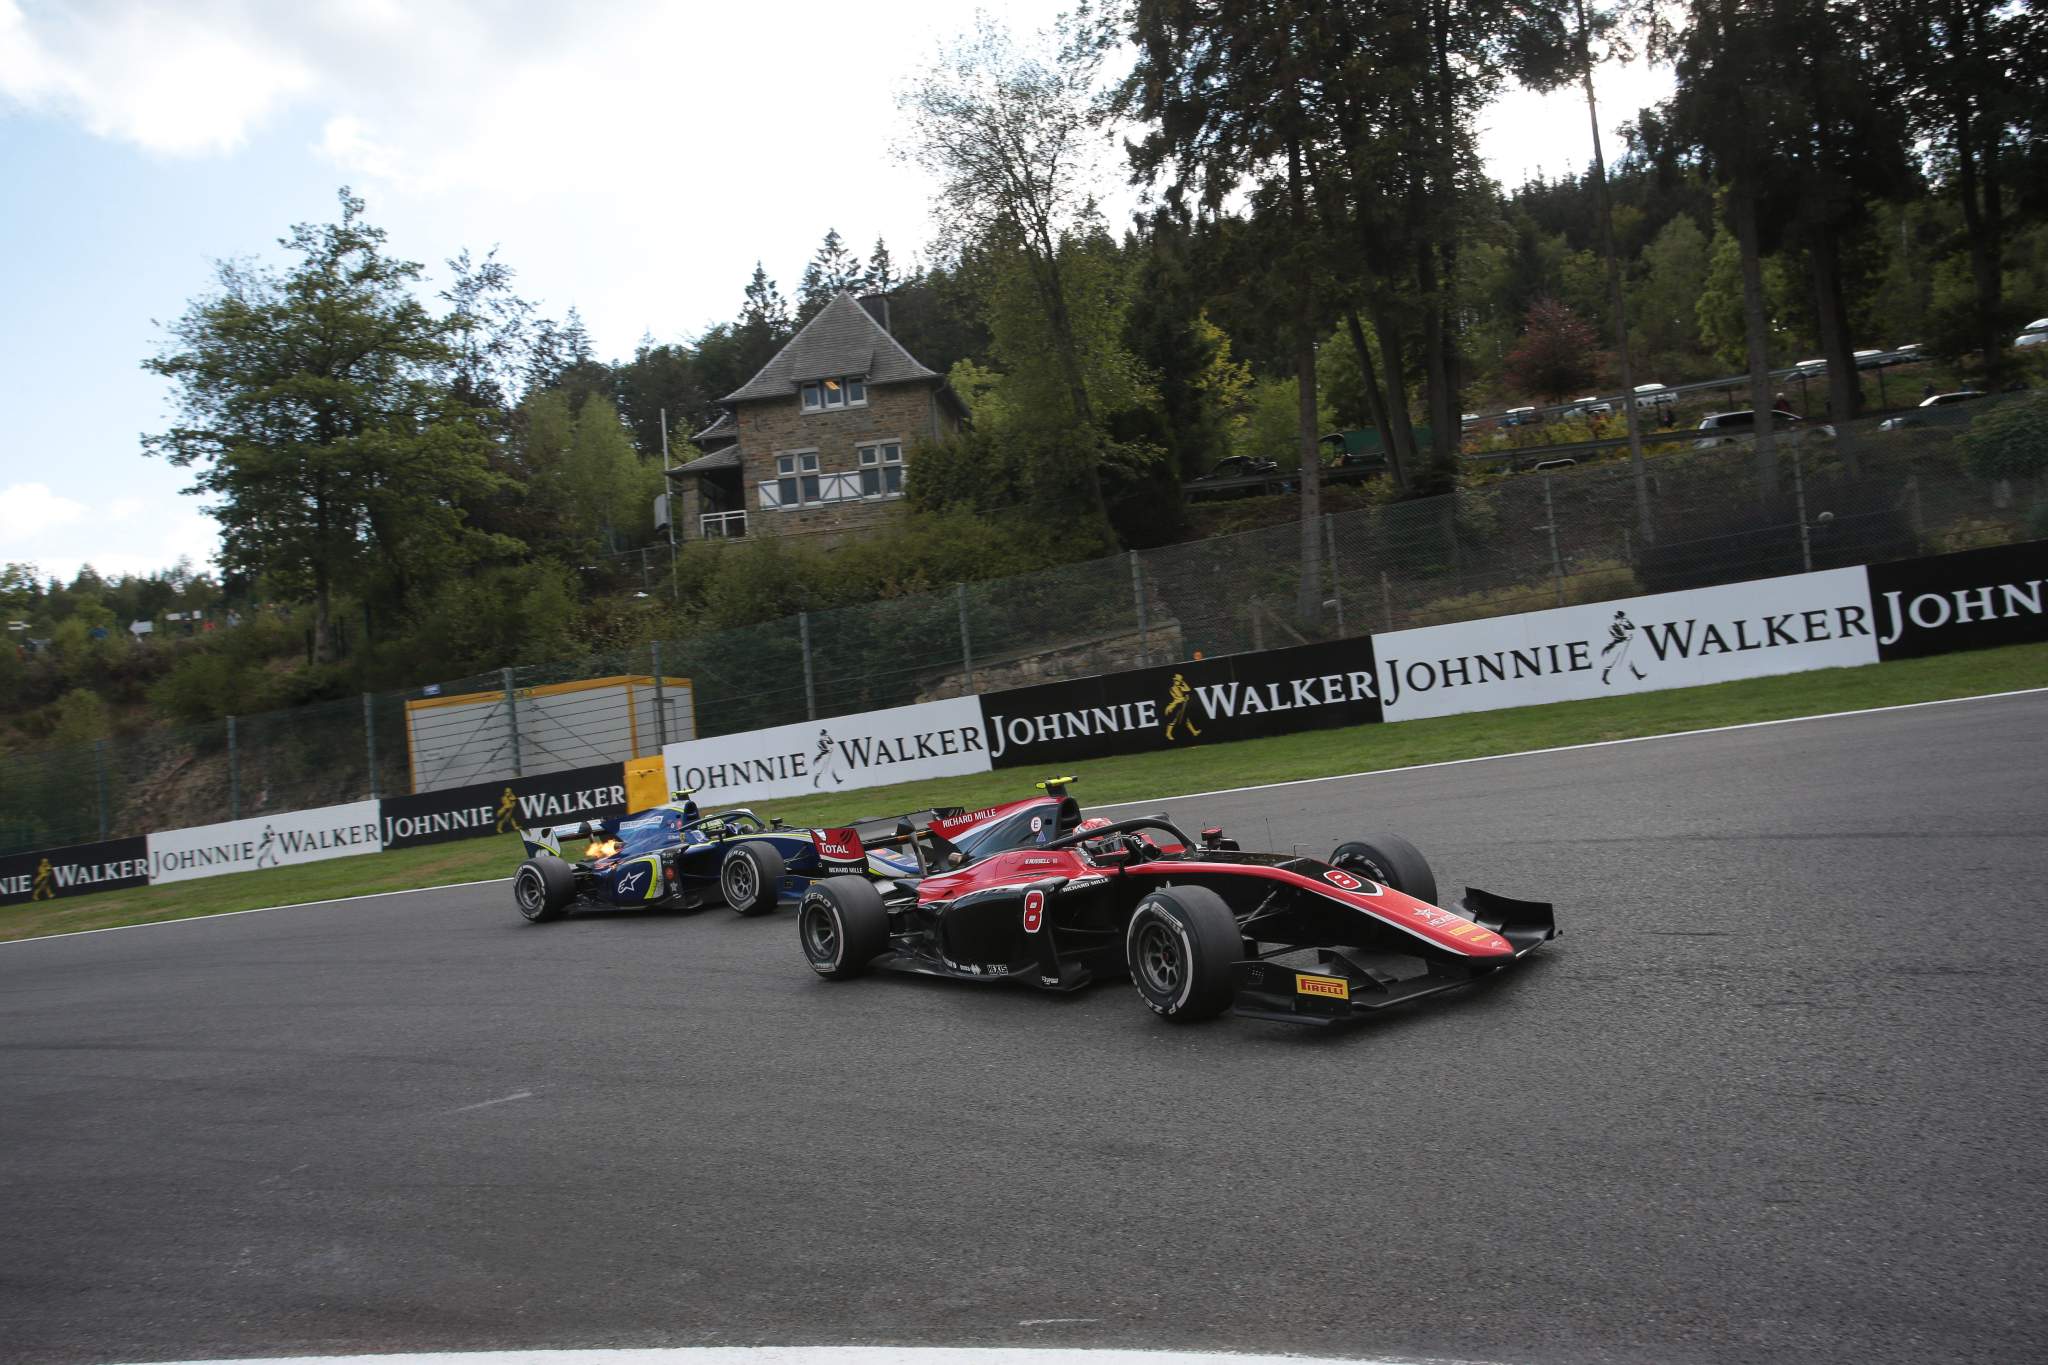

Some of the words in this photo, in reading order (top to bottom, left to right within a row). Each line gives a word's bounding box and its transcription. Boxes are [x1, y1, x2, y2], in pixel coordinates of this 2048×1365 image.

[1879, 579, 2048, 645] JOHN
[1384, 640, 1593, 705] JOHNNIE
[1641, 605, 1871, 662] WALKER
[991, 699, 1159, 757] JOHNNIE
[1194, 671, 1378, 720] WALKER
[672, 752, 809, 792] JOHNNIE
[838, 726, 983, 768] WALKER
[383, 806, 495, 846] JOHNNIE
[519, 785, 627, 819] WALKER
[942, 814, 973, 828] RICHARD
[974, 808, 997, 820] MILLE
[151, 841, 254, 879] JOHNNIE
[278, 823, 379, 854] WALKER
[819, 842, 849, 854] TOTAL
[53, 858, 149, 887] WALKER
[1062, 882, 1090, 893] RICHARD
[1090, 878, 1109, 886] MILLE
[1323, 870, 1362, 890] 8
[1023, 889, 1045, 933] 8
[1301, 979, 1344, 995] PIRELLI
